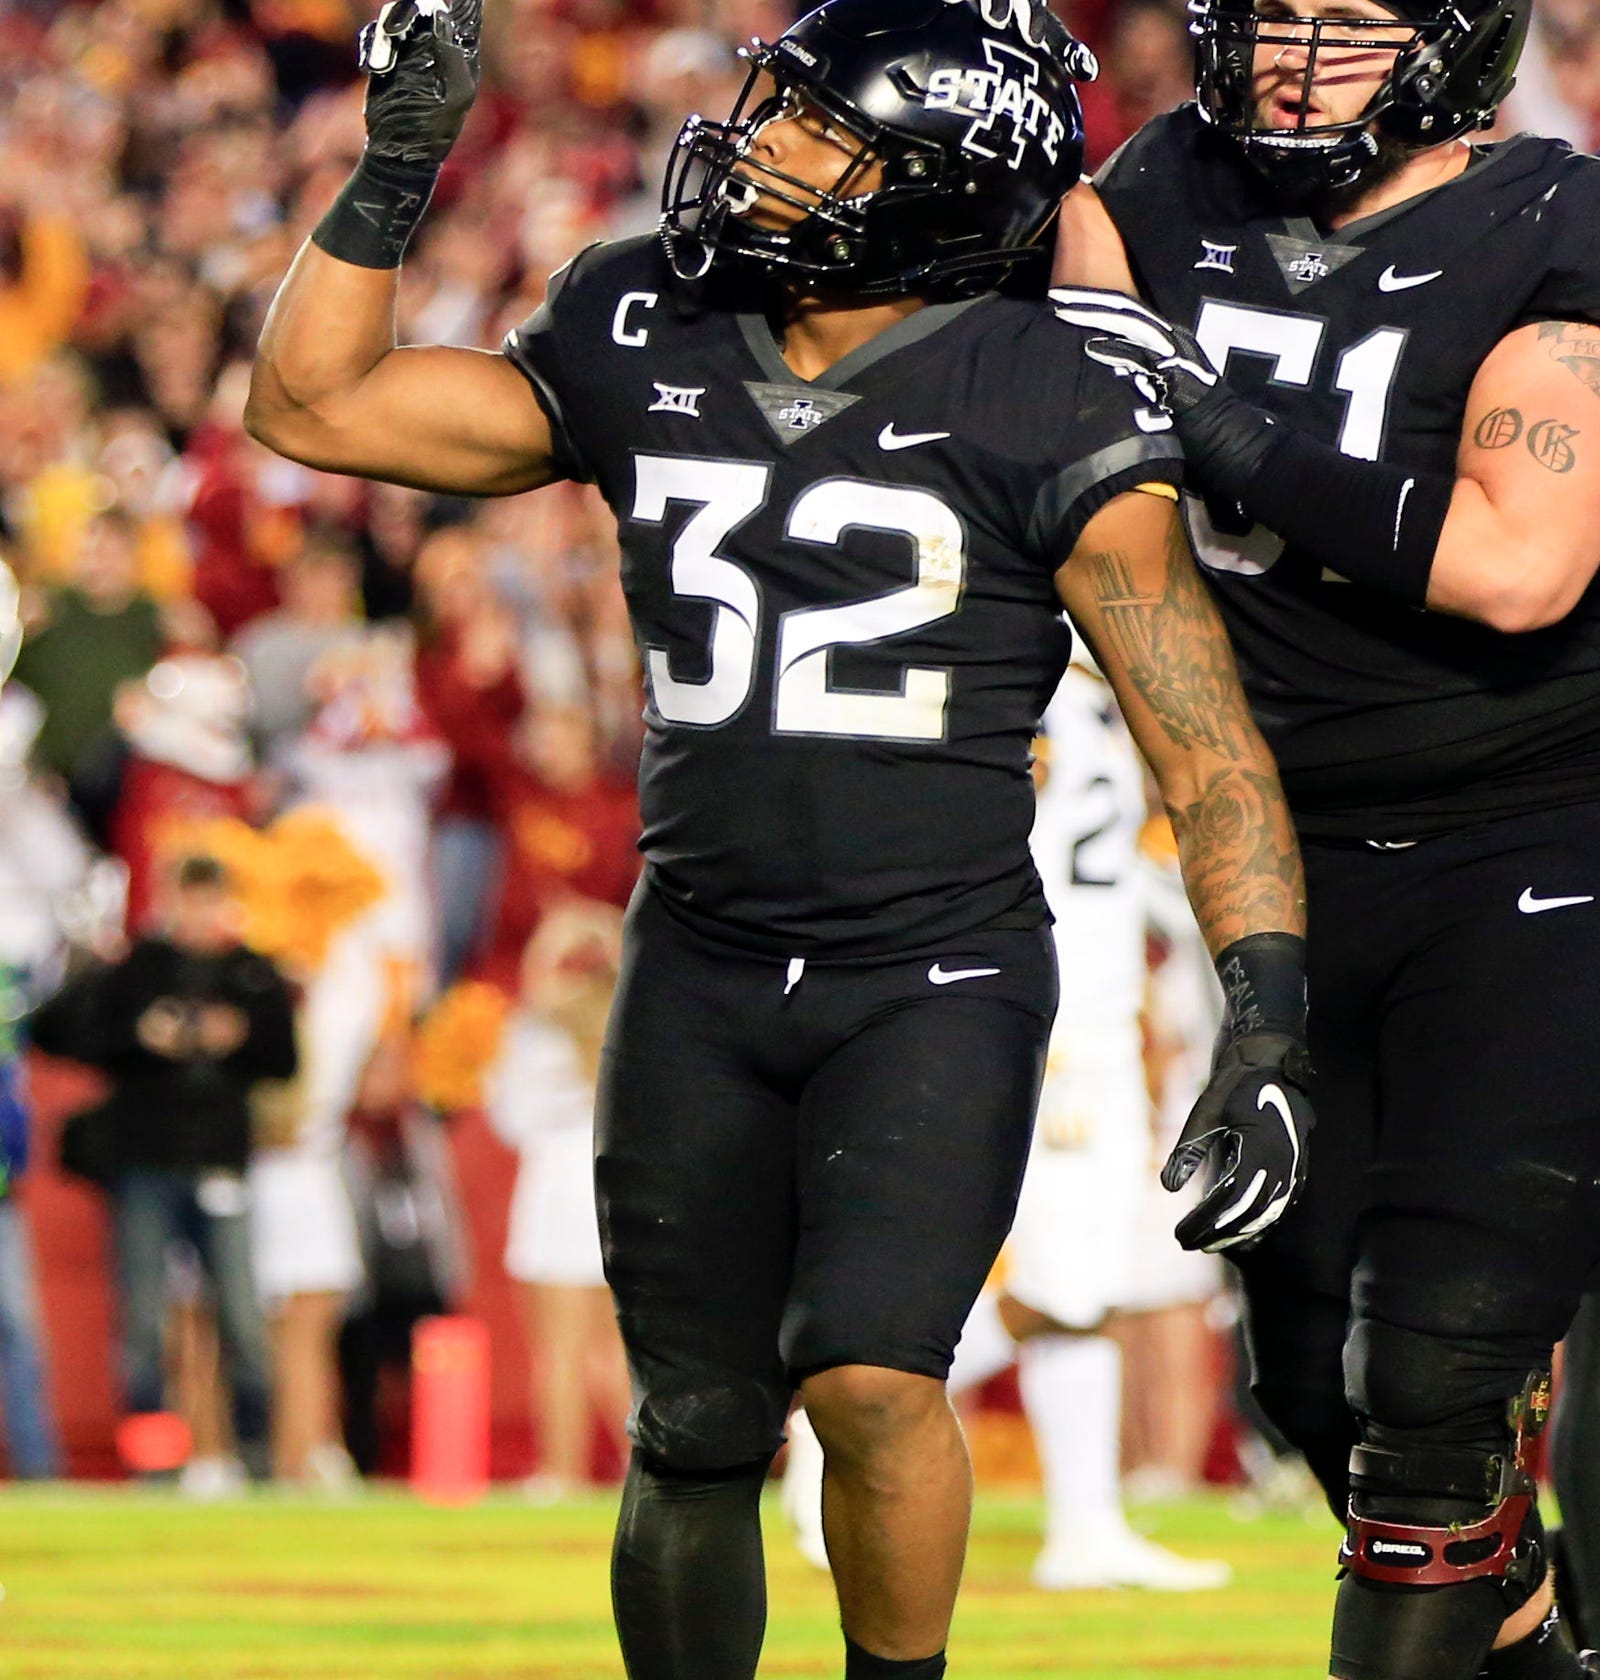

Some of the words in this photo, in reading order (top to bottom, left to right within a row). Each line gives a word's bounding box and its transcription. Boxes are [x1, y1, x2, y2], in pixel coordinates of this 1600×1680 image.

[924, 68, 1066, 167] STATE
[1287, 259, 1330, 277] STATE
[611, 291, 659, 348] C
[777, 407, 823, 425] STATE
[1473, 407, 1581, 474] OG
[627, 447, 968, 744] 32
